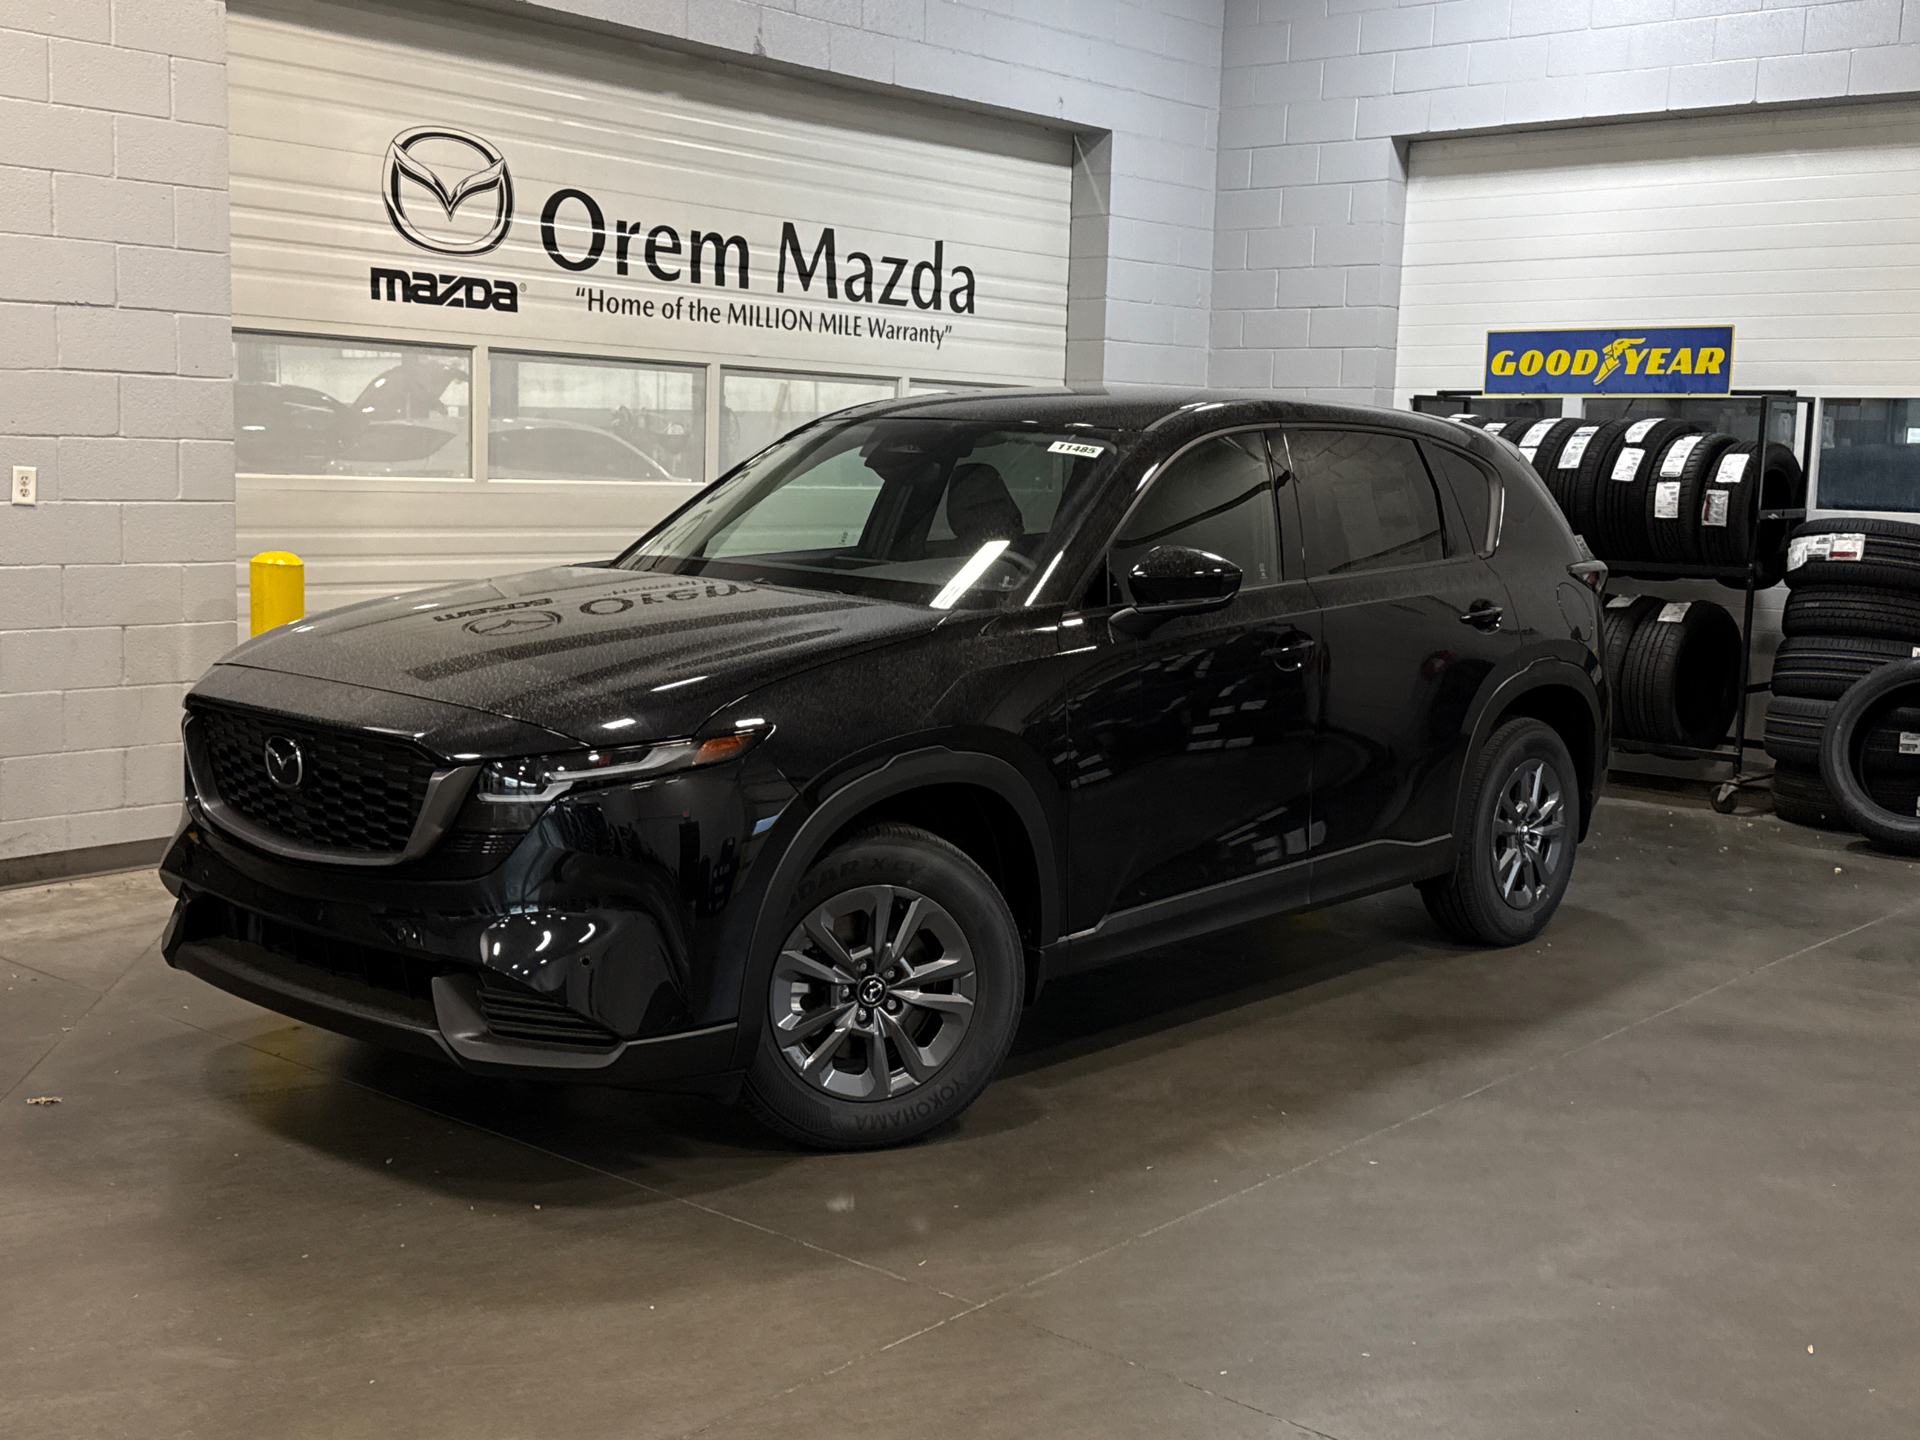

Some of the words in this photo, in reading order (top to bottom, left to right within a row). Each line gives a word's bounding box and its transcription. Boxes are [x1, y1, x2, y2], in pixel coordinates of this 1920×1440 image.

[540, 188, 749, 290] Orem
[777, 222, 976, 314] Mazda
[661, 296, 684, 319] of
[688, 299, 721, 323] the
[727, 302, 812, 332] MILLION
[819, 312, 862, 336] MILE
[1058, 444, 1096, 454] 11485
[855, 1079, 965, 1130] YOKOHAMA
